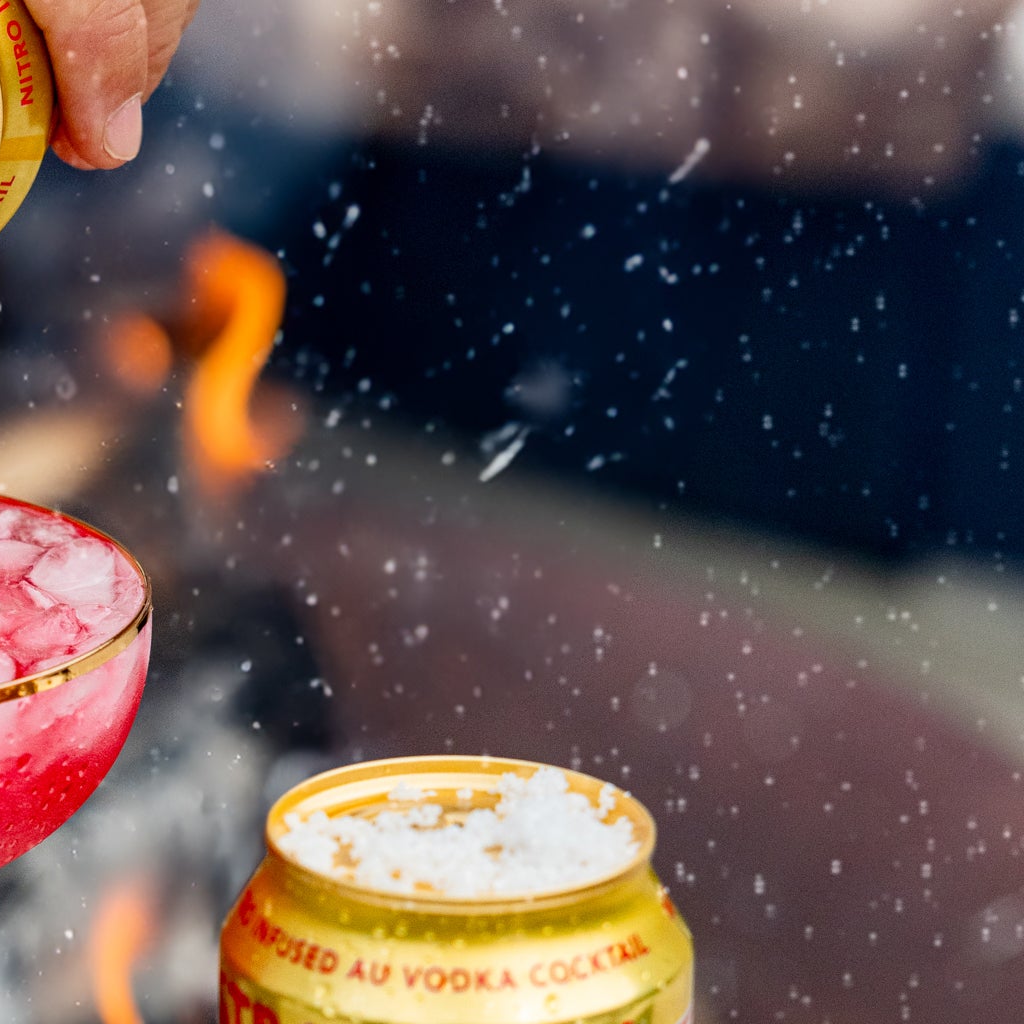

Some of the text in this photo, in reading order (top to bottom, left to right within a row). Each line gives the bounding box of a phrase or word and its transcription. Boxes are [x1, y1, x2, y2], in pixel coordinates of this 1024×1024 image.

[6, 20, 34, 106] NITRO
[347, 957, 391, 986] AU
[403, 965, 518, 993] VODKA
[529, 932, 651, 986] COCKTAIL
